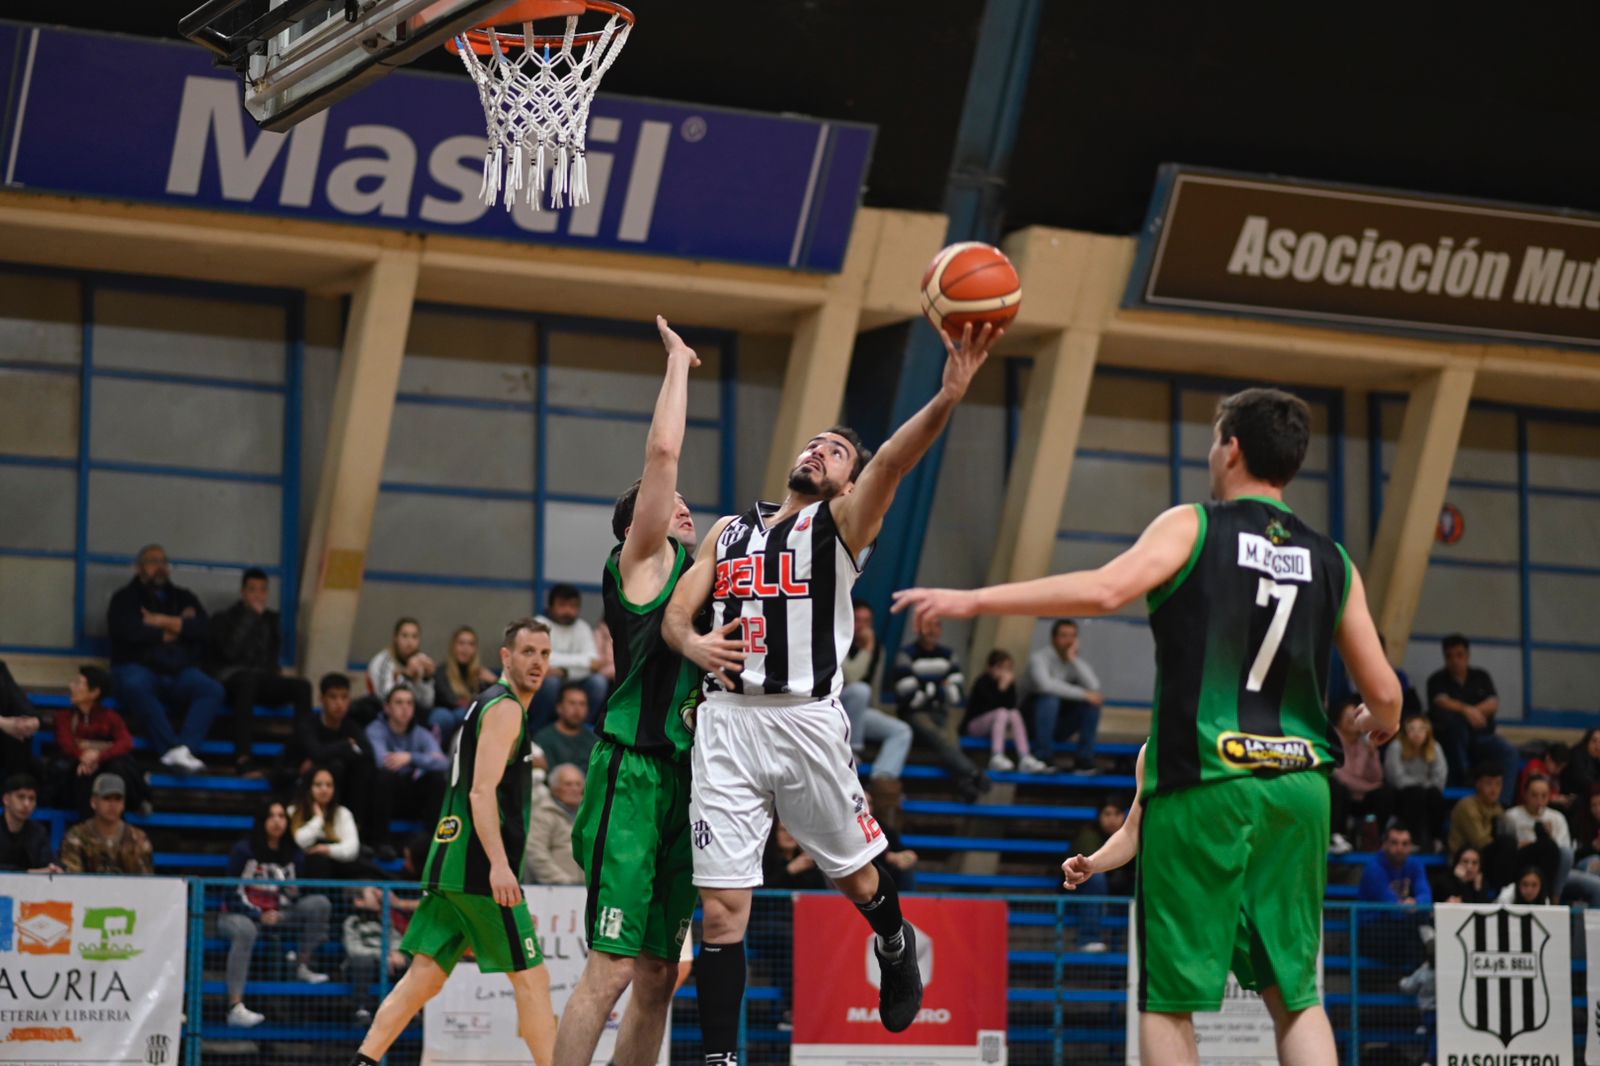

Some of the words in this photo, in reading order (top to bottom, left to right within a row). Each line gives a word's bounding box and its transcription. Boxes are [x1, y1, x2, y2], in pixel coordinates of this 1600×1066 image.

[166, 75, 672, 242] Mastil
[1227, 215, 1510, 300] Asociación
[713, 552, 809, 600] BELL
[1245, 577, 1298, 692] 7
[524, 937, 536, 959] 9
[0, 968, 131, 1002] AURIA
[51, 1010, 61, 1022] Y
[64, 1010, 132, 1023] LIBRERIA
[846, 1007, 951, 1024] MARO
